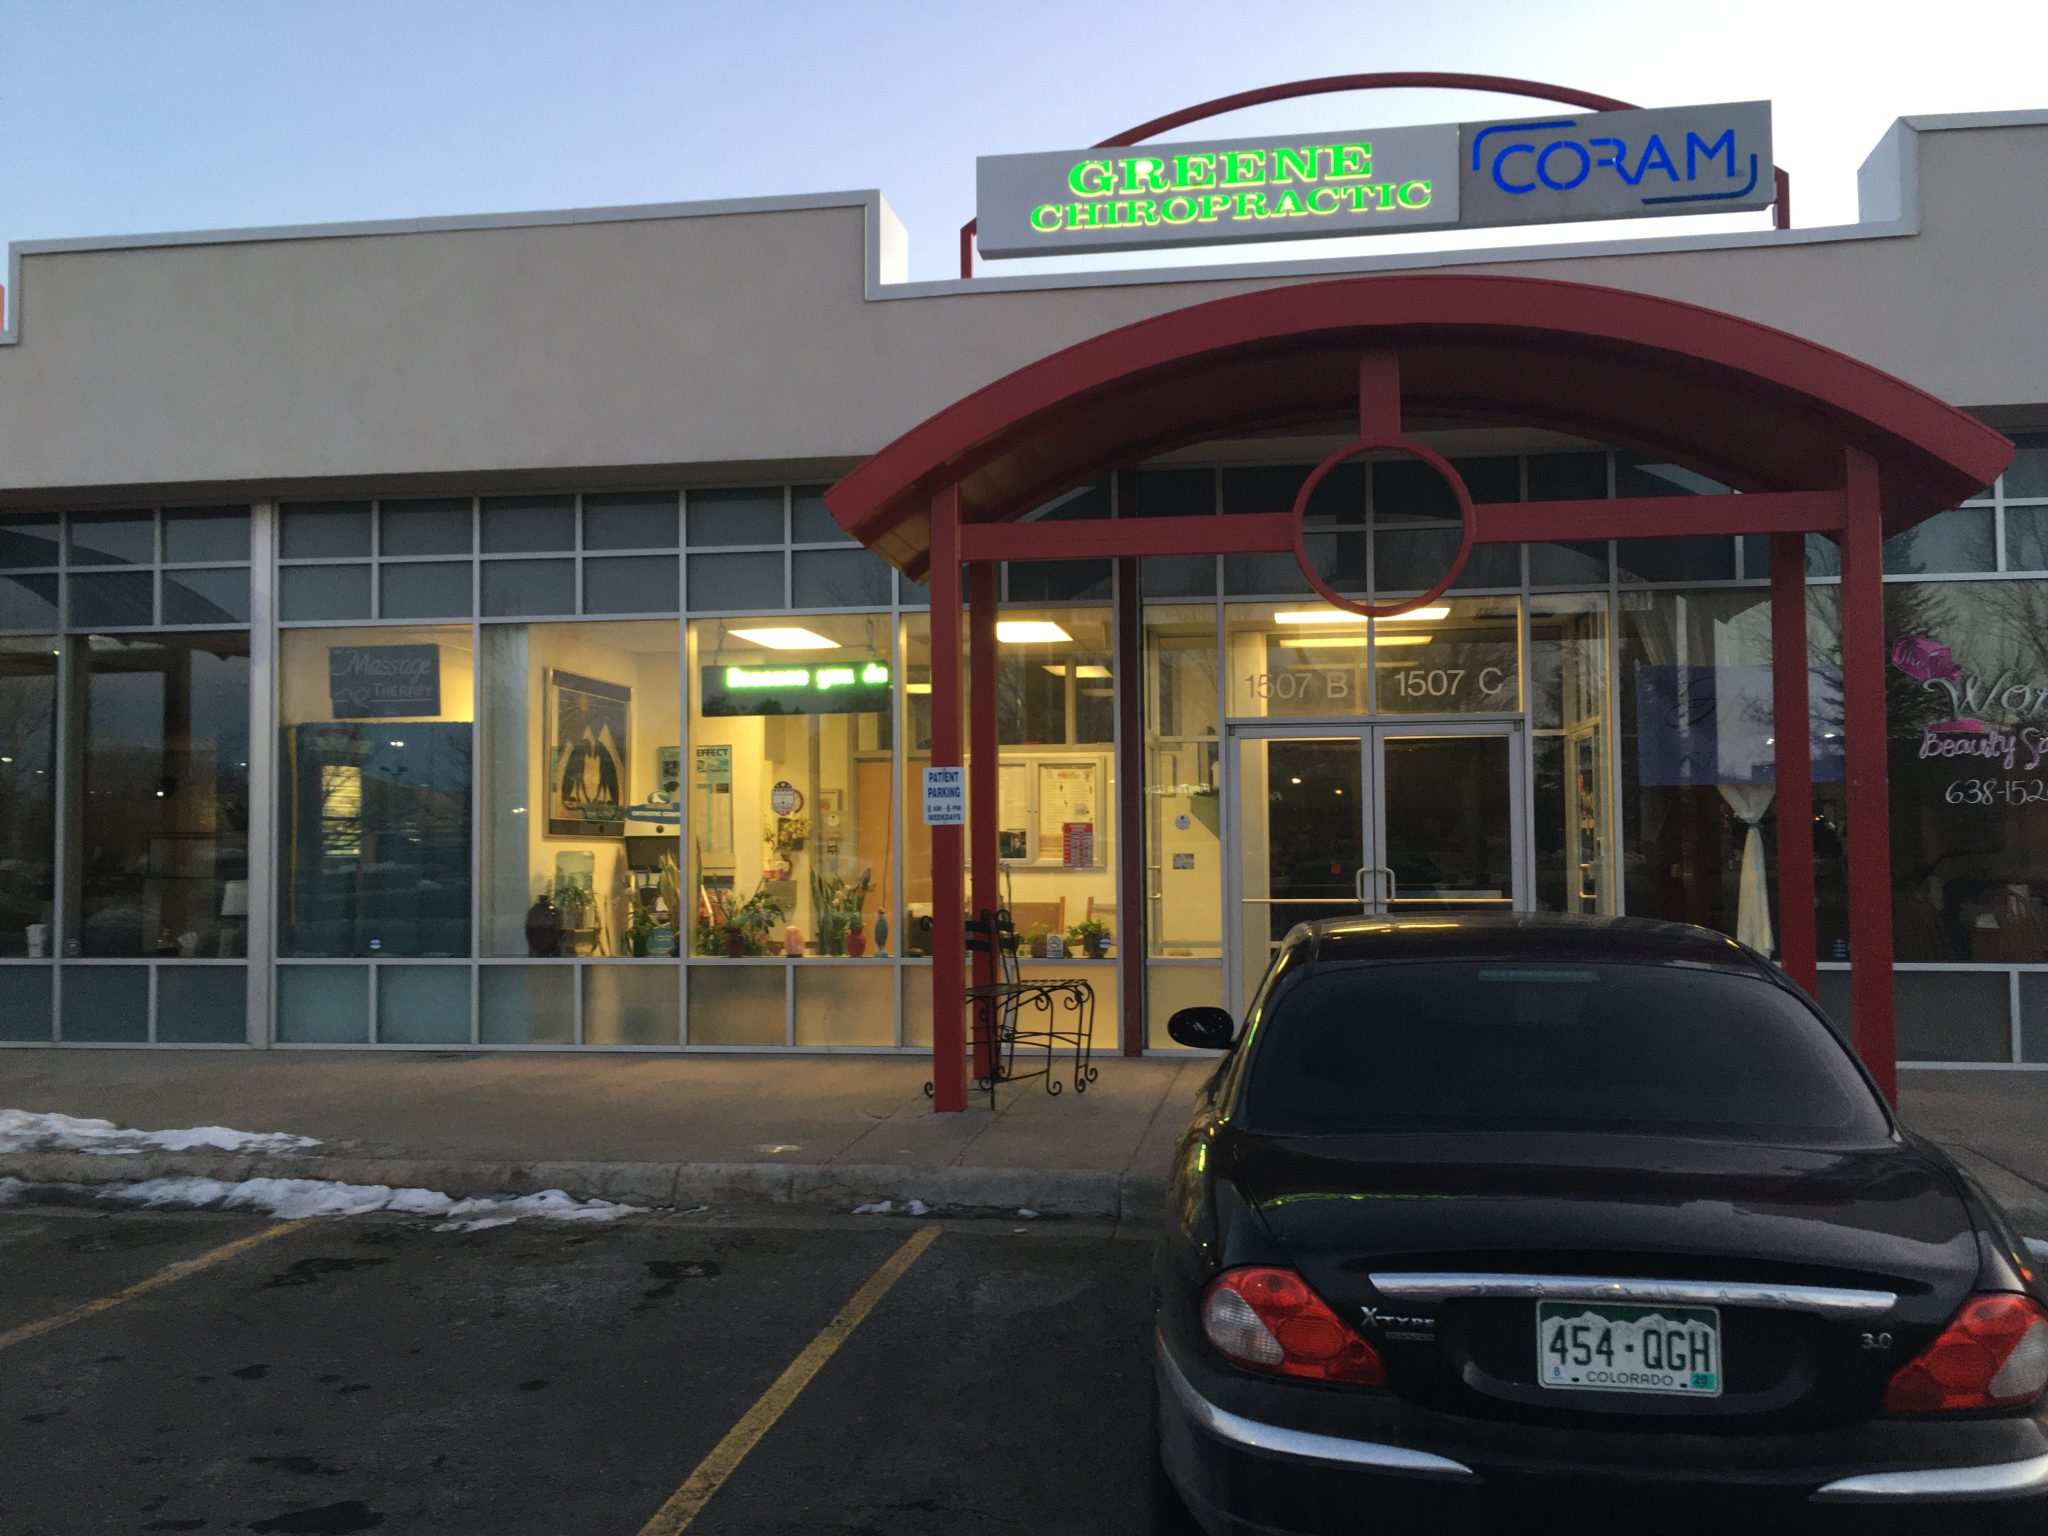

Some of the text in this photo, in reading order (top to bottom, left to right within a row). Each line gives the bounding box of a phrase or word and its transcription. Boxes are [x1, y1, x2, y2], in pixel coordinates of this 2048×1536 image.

[1068, 143, 1373, 198] GREENE
[1492, 129, 1735, 194] CORAM
[1030, 180, 1433, 232] CHIROPRACTIC
[331, 649, 434, 685] Massage
[373, 682, 432, 697] THERAPY
[1244, 671, 1348, 700] 1507 B
[1394, 668, 1503, 697] 1507 C
[1918, 727, 2016, 770] Beauty
[928, 771, 959, 783] PATIENT
[1945, 778, 2048, 805] 638-152
[927, 786, 960, 798] PARKING
[928, 813, 960, 821] WEEKDAYS
[1586, 1371, 1674, 1386] COLORADO
